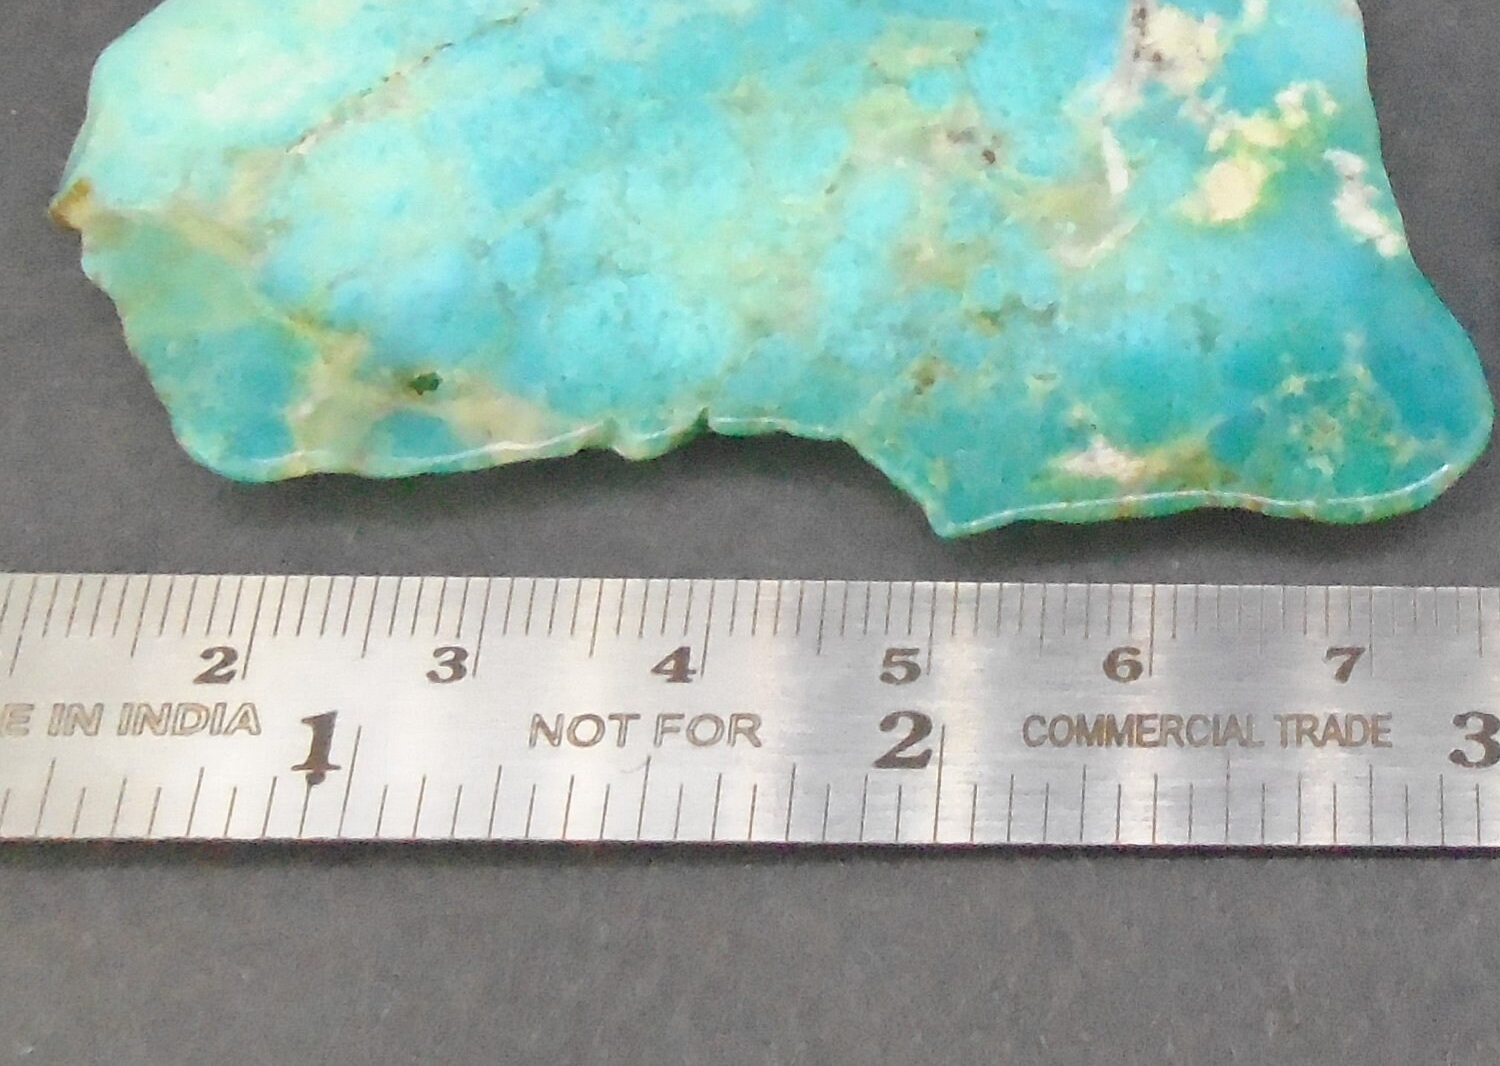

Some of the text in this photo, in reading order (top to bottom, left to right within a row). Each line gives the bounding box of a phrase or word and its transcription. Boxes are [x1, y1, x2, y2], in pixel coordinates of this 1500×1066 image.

[194, 646, 239, 684] 2
[427, 646, 469, 684] 3
[651, 646, 697, 684] 4
[879, 647, 921, 685] 5
[1102, 647, 1143, 684] 6
[1325, 647, 1368, 684] 7
[47, 702, 104, 737] IN
[116, 702, 262, 736] INDIA
[528, 713, 764, 748] NOT FOR
[1022, 713, 1394, 748] COMMERCIAL TRADE
[292, 710, 341, 785] 1
[873, 710, 933, 770] 2
